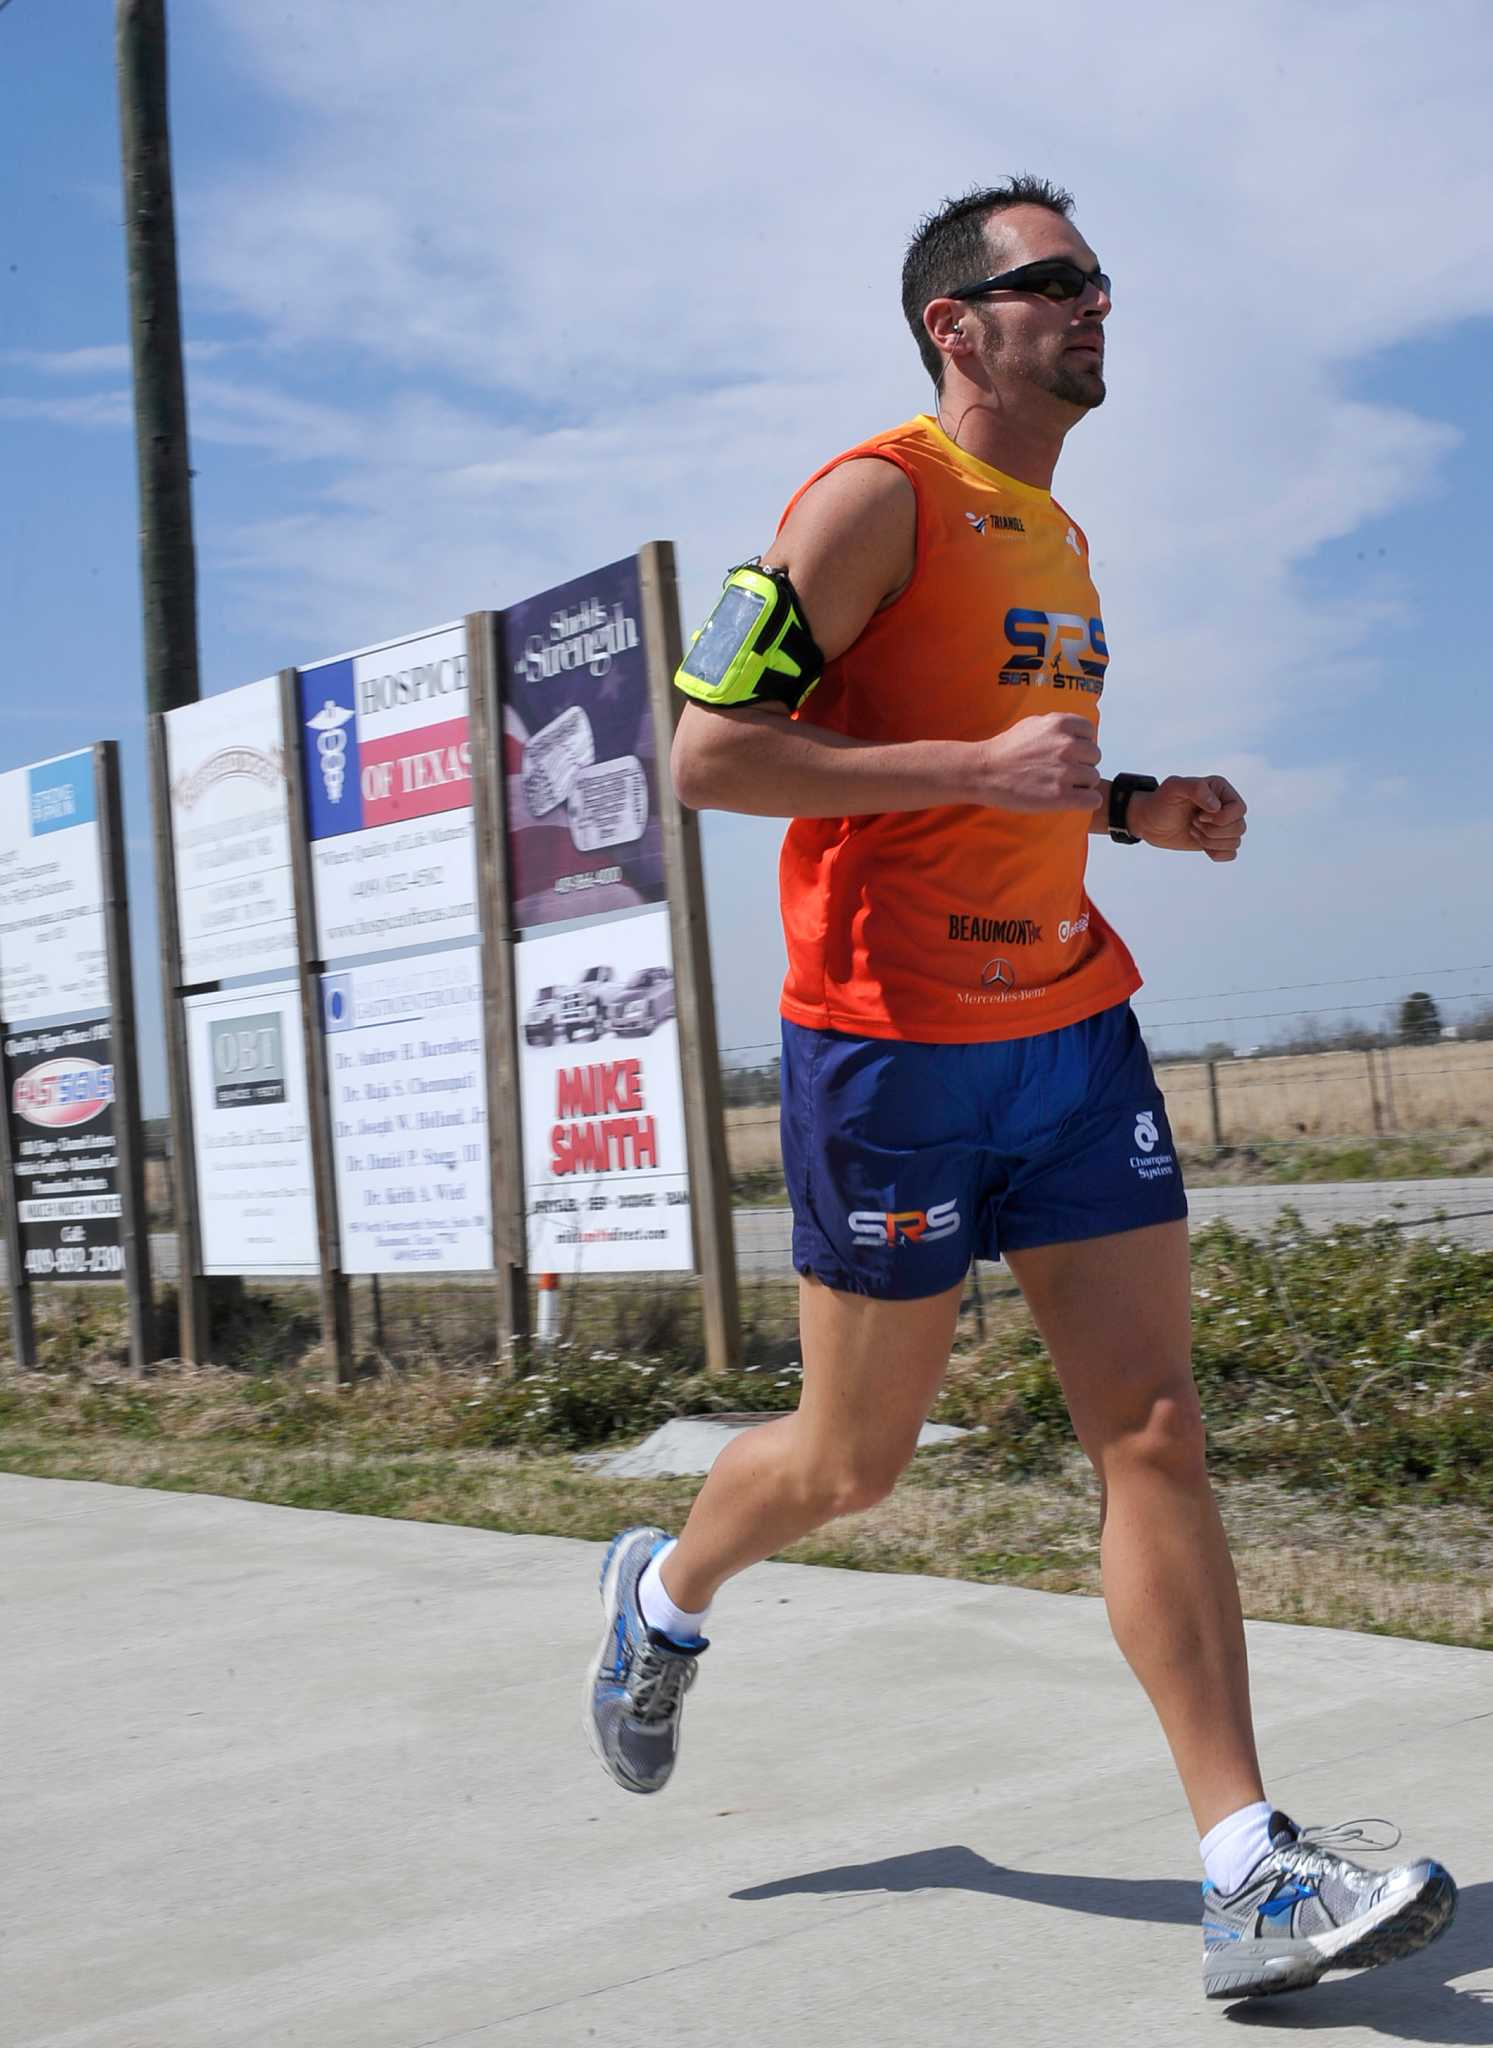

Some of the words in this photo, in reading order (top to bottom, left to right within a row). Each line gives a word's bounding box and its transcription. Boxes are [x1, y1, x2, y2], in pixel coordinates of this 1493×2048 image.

[359, 654, 468, 715] HOSPICE
[361, 761, 394, 801] OF
[398, 742, 472, 793] TEXAS
[948, 914, 1032, 946] BEAUMONT
[955, 987, 1047, 1006] Mercedes-Benz
[556, 1058, 643, 1120] MIKE
[552, 1115, 657, 1176] SMITH
[1137, 1166, 1174, 1180] System
[848, 1198, 960, 1247] SRS
